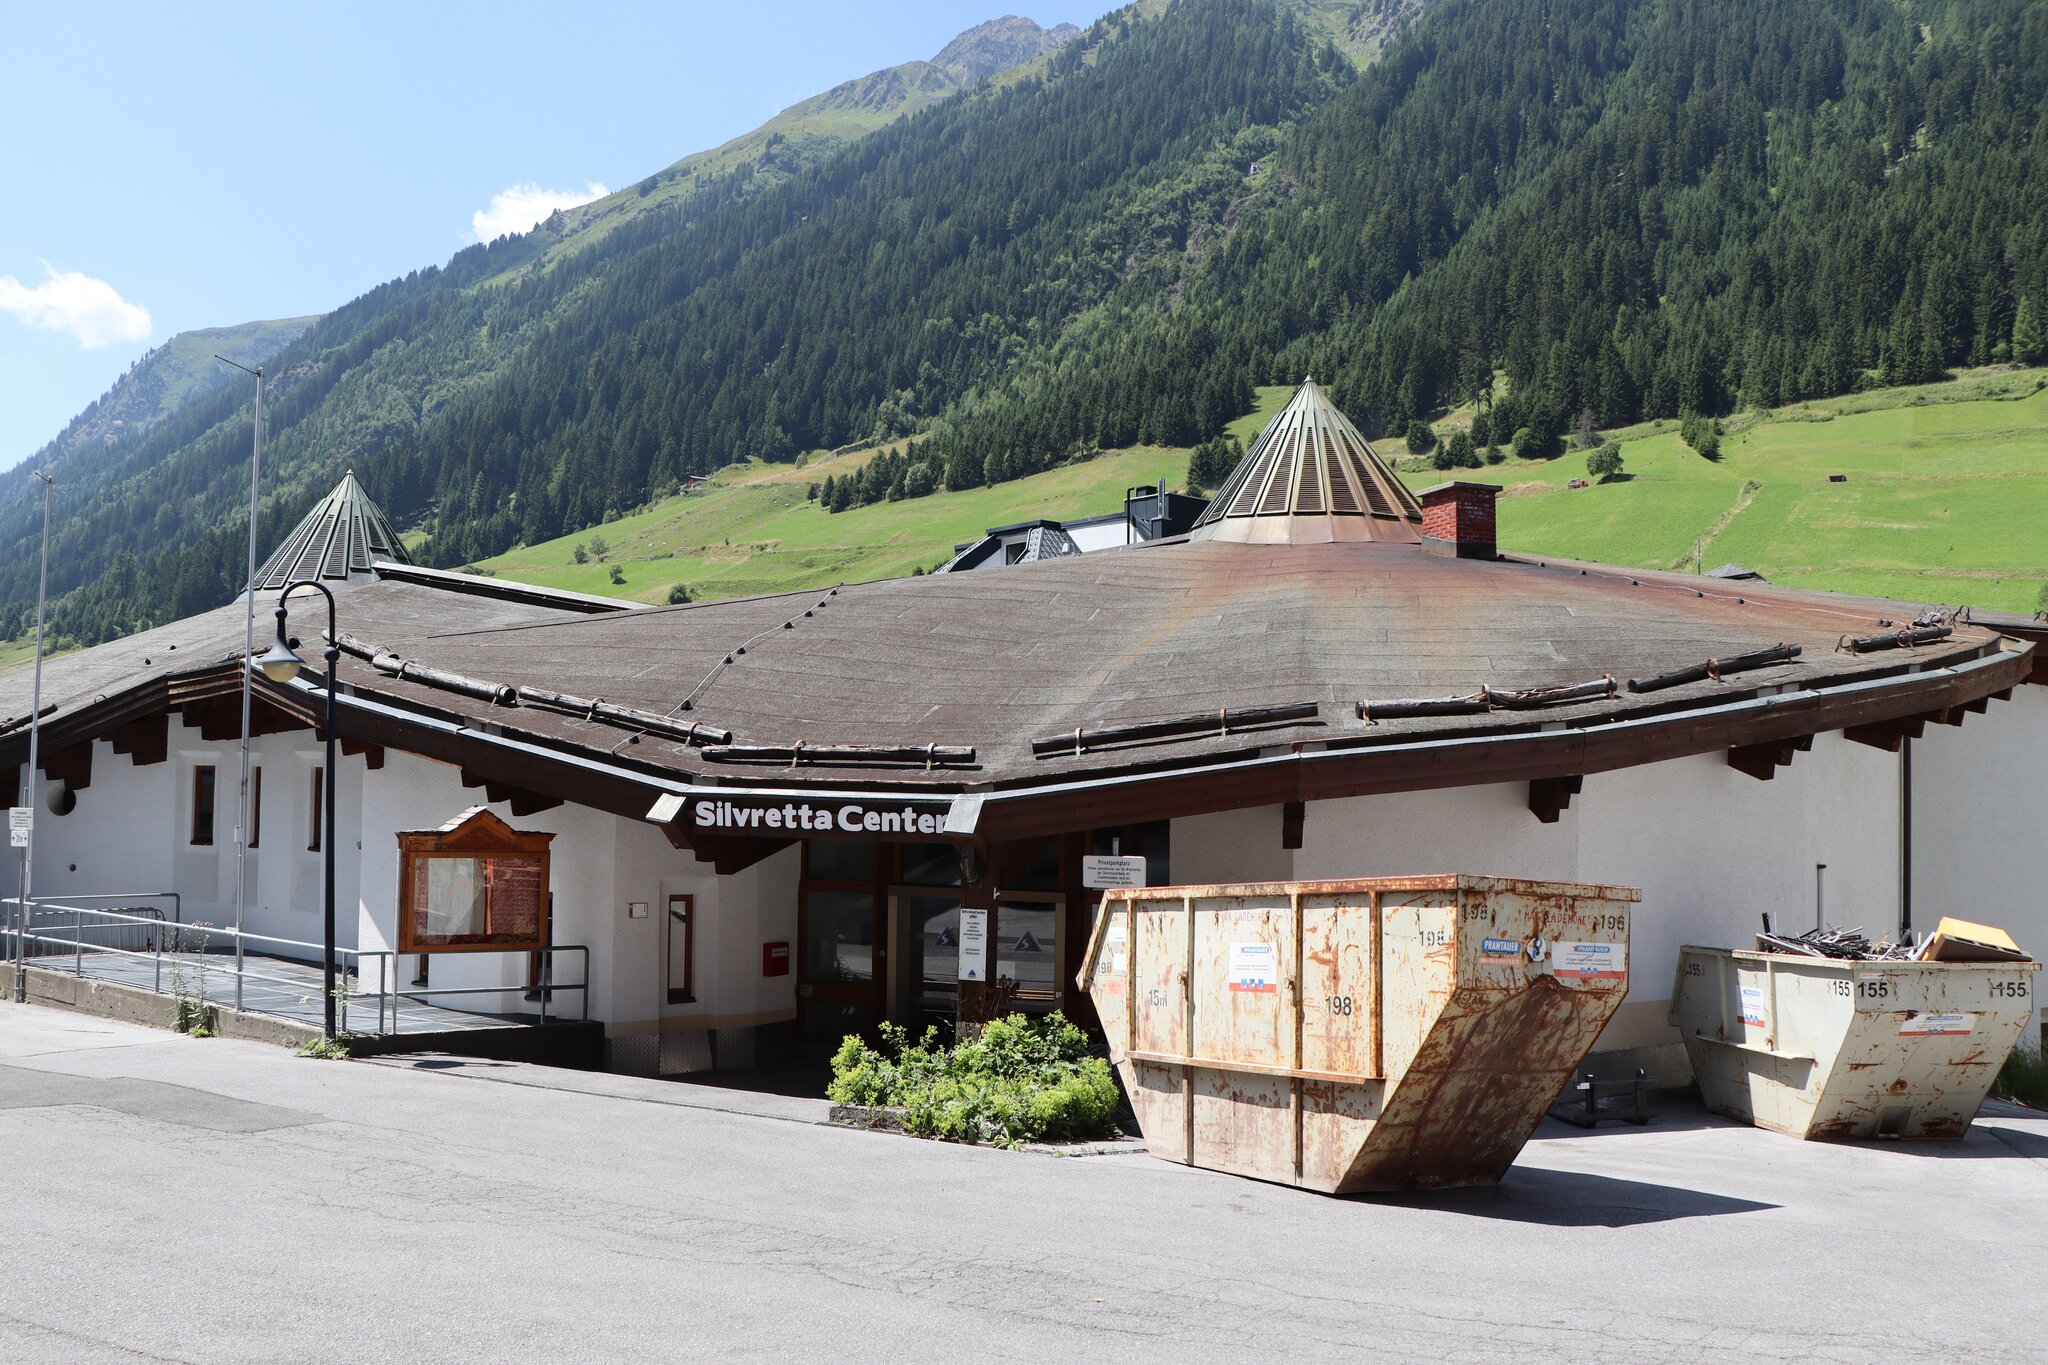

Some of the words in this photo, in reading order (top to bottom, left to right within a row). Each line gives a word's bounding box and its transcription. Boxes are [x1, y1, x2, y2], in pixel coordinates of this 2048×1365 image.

[695, 801, 833, 830] Silvretta
[837, 805, 948, 834] Center
[1461, 903, 1489, 921] 198
[1600, 914, 1625, 930] 198
[1419, 930, 1445, 946] 198
[1484, 940, 1519, 952] PRANTAUER
[1687, 962, 1701, 977] 155
[1832, 980, 1850, 997] 155
[1857, 981, 1888, 998] 155
[1996, 981, 2027, 998] 155
[1325, 995, 1352, 1016] 198
